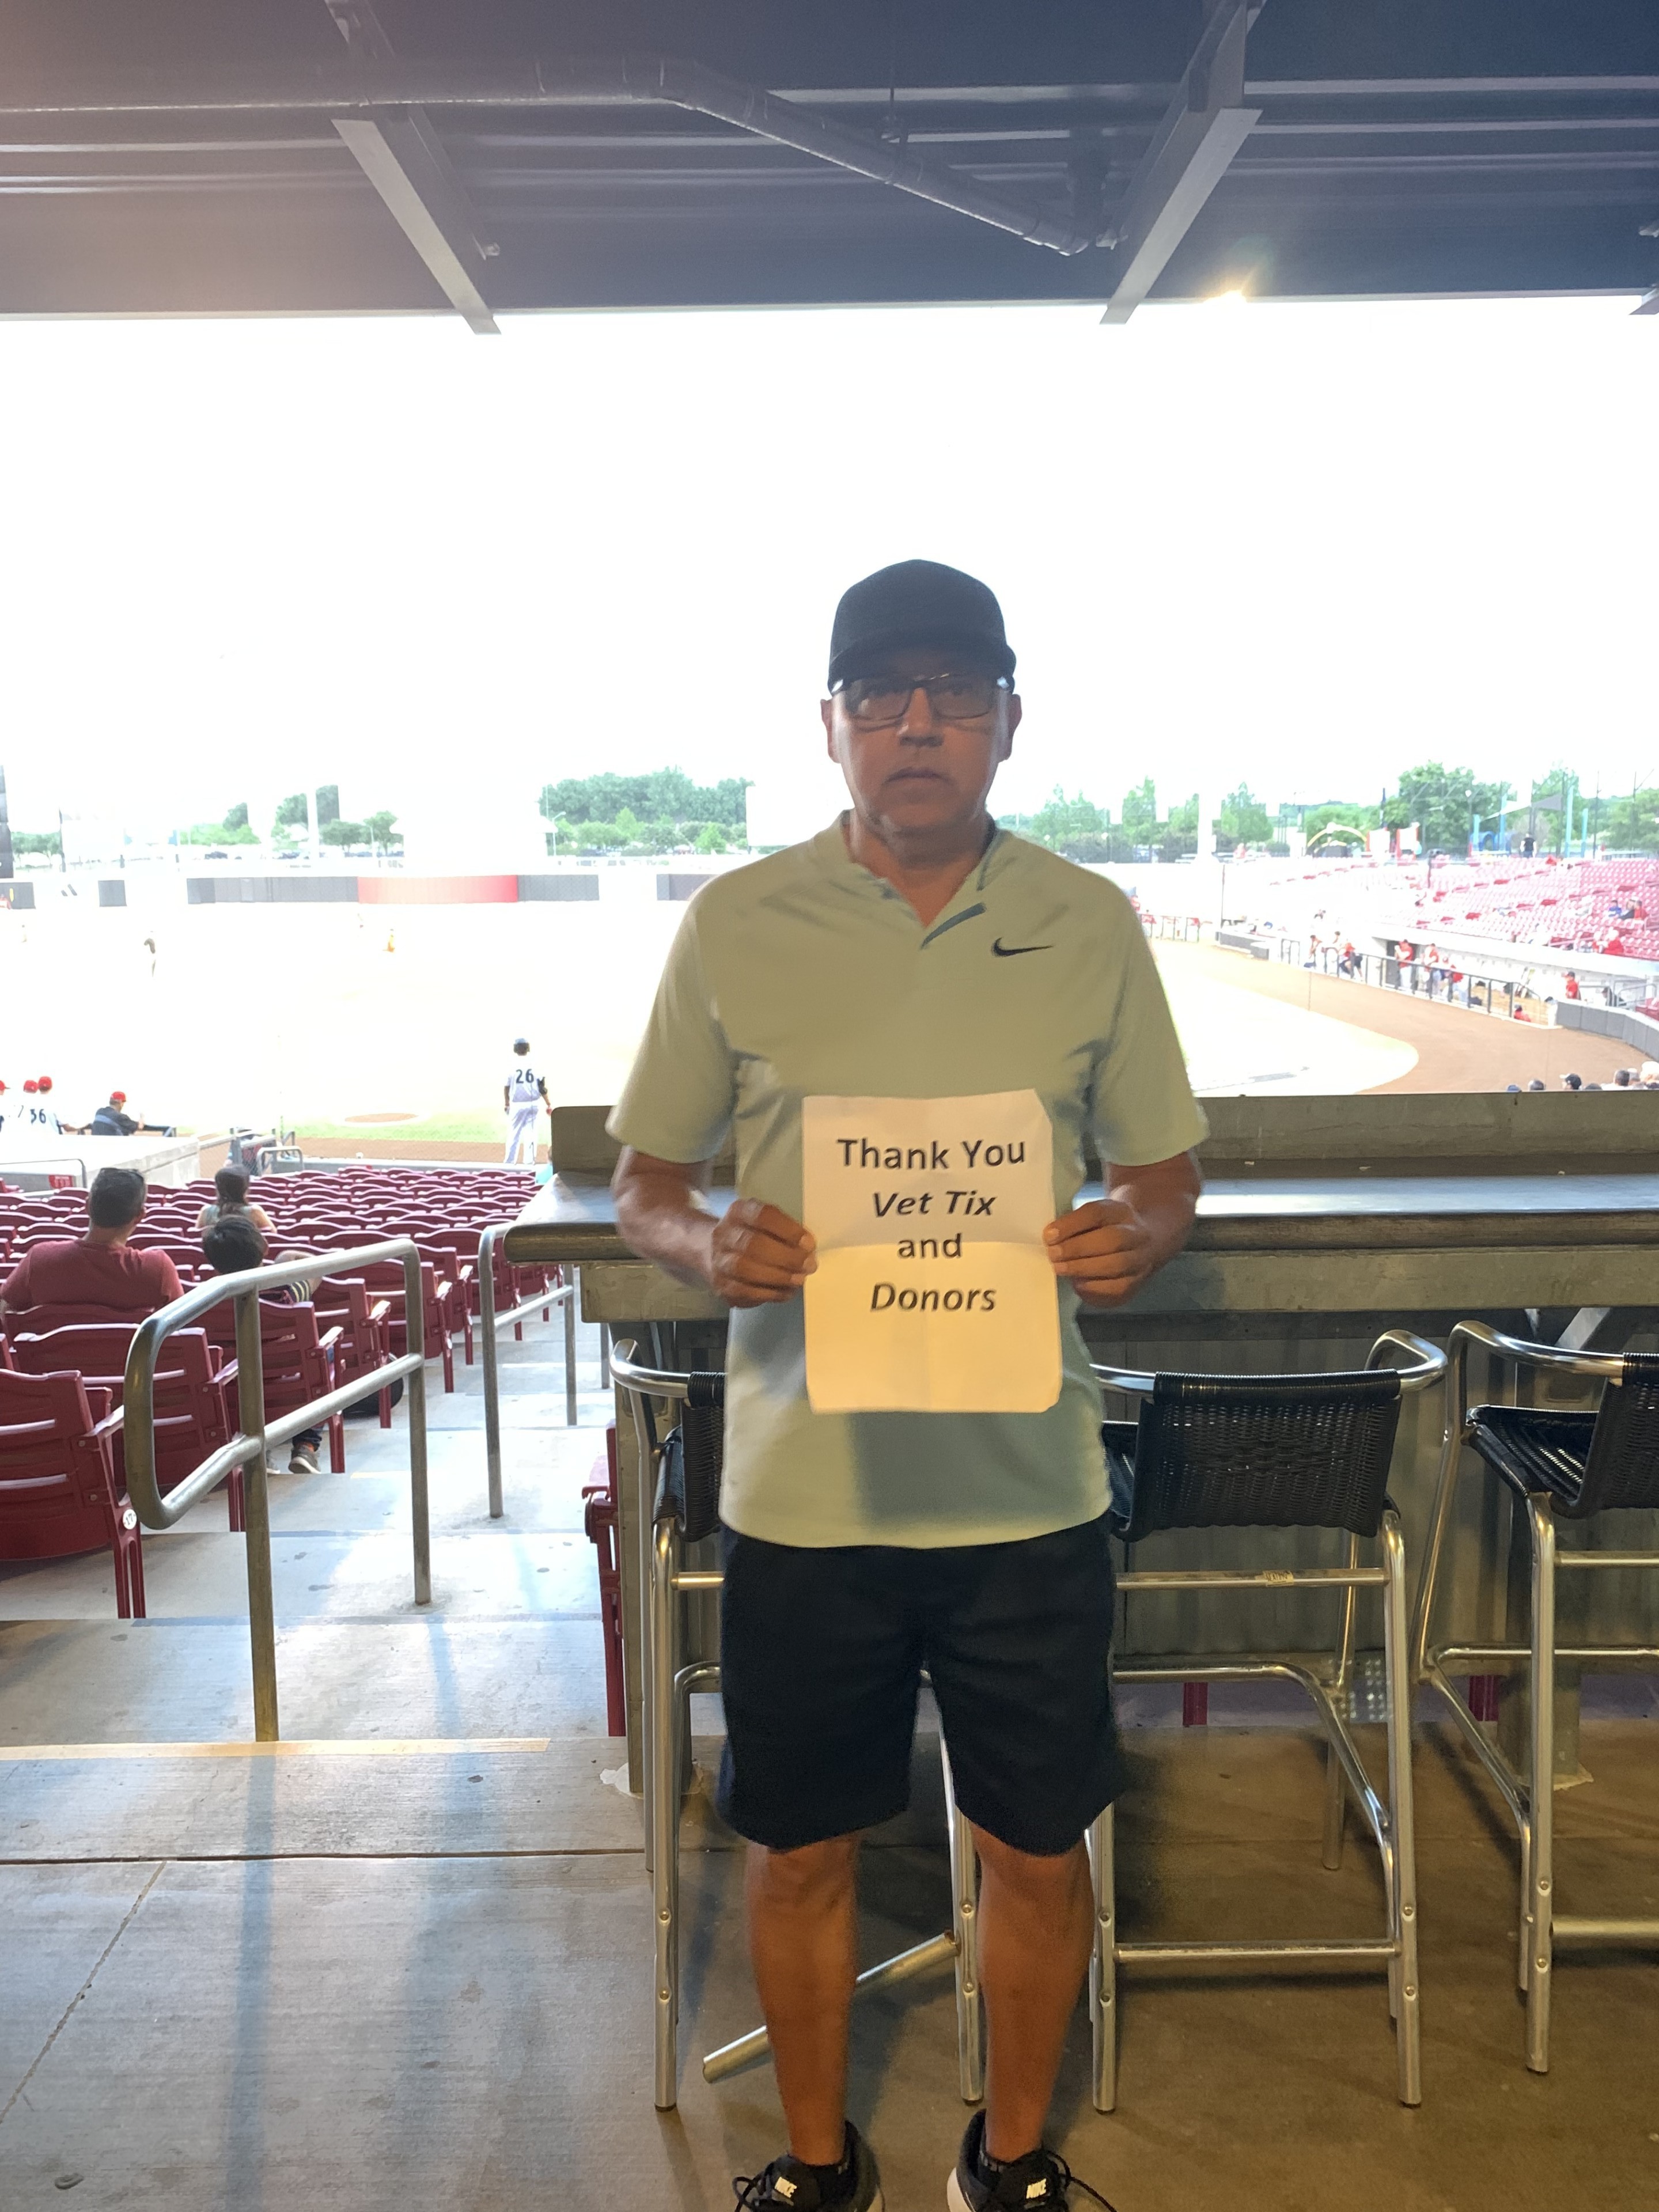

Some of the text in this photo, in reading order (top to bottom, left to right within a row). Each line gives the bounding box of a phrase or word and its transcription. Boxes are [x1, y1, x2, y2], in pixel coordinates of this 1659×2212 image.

[516, 1069, 535, 1084] 26
[836, 1138, 1025, 1170] Thank You
[873, 1190, 997, 1218] Vet Tix
[897, 1232, 963, 1259] and
[870, 1282, 997, 1312] Donors
[126, 1513, 133, 1525] 17
